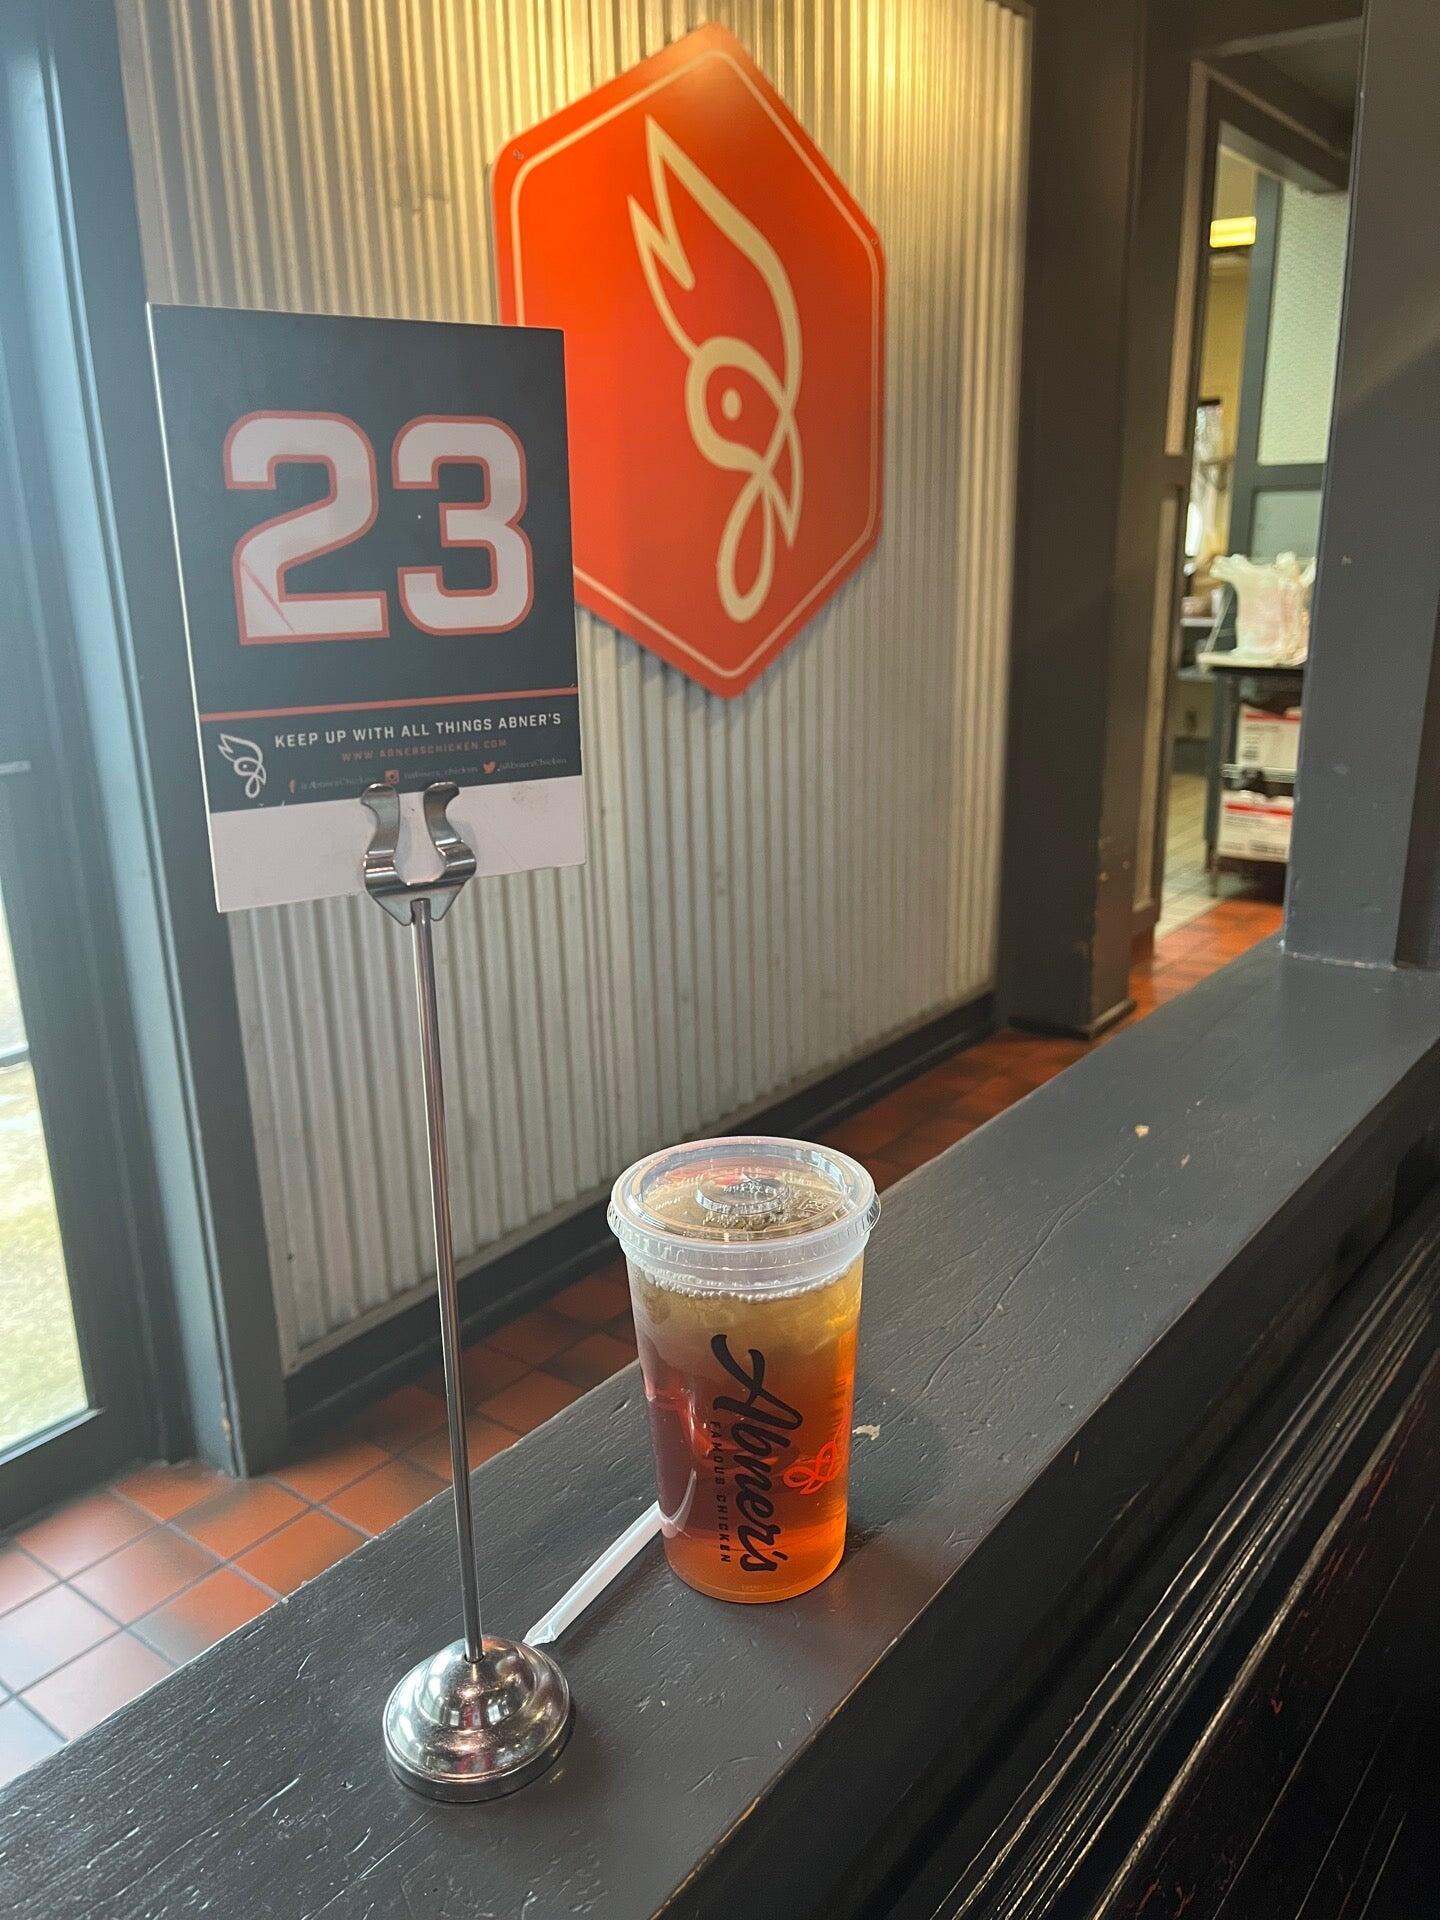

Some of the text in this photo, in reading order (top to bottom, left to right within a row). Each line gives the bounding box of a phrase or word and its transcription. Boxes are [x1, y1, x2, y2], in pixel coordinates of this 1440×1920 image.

[223, 409, 535, 646] 23
[274, 712, 562, 749] KEEP UP WITH ALL THINGS ABNER'S
[341, 738, 507, 763] WWW.ABNERSCHICKEN.COM
[709, 1420, 731, 1563] FAMOUS CHICKEN
[710, 1333, 804, 1572] Abner's
